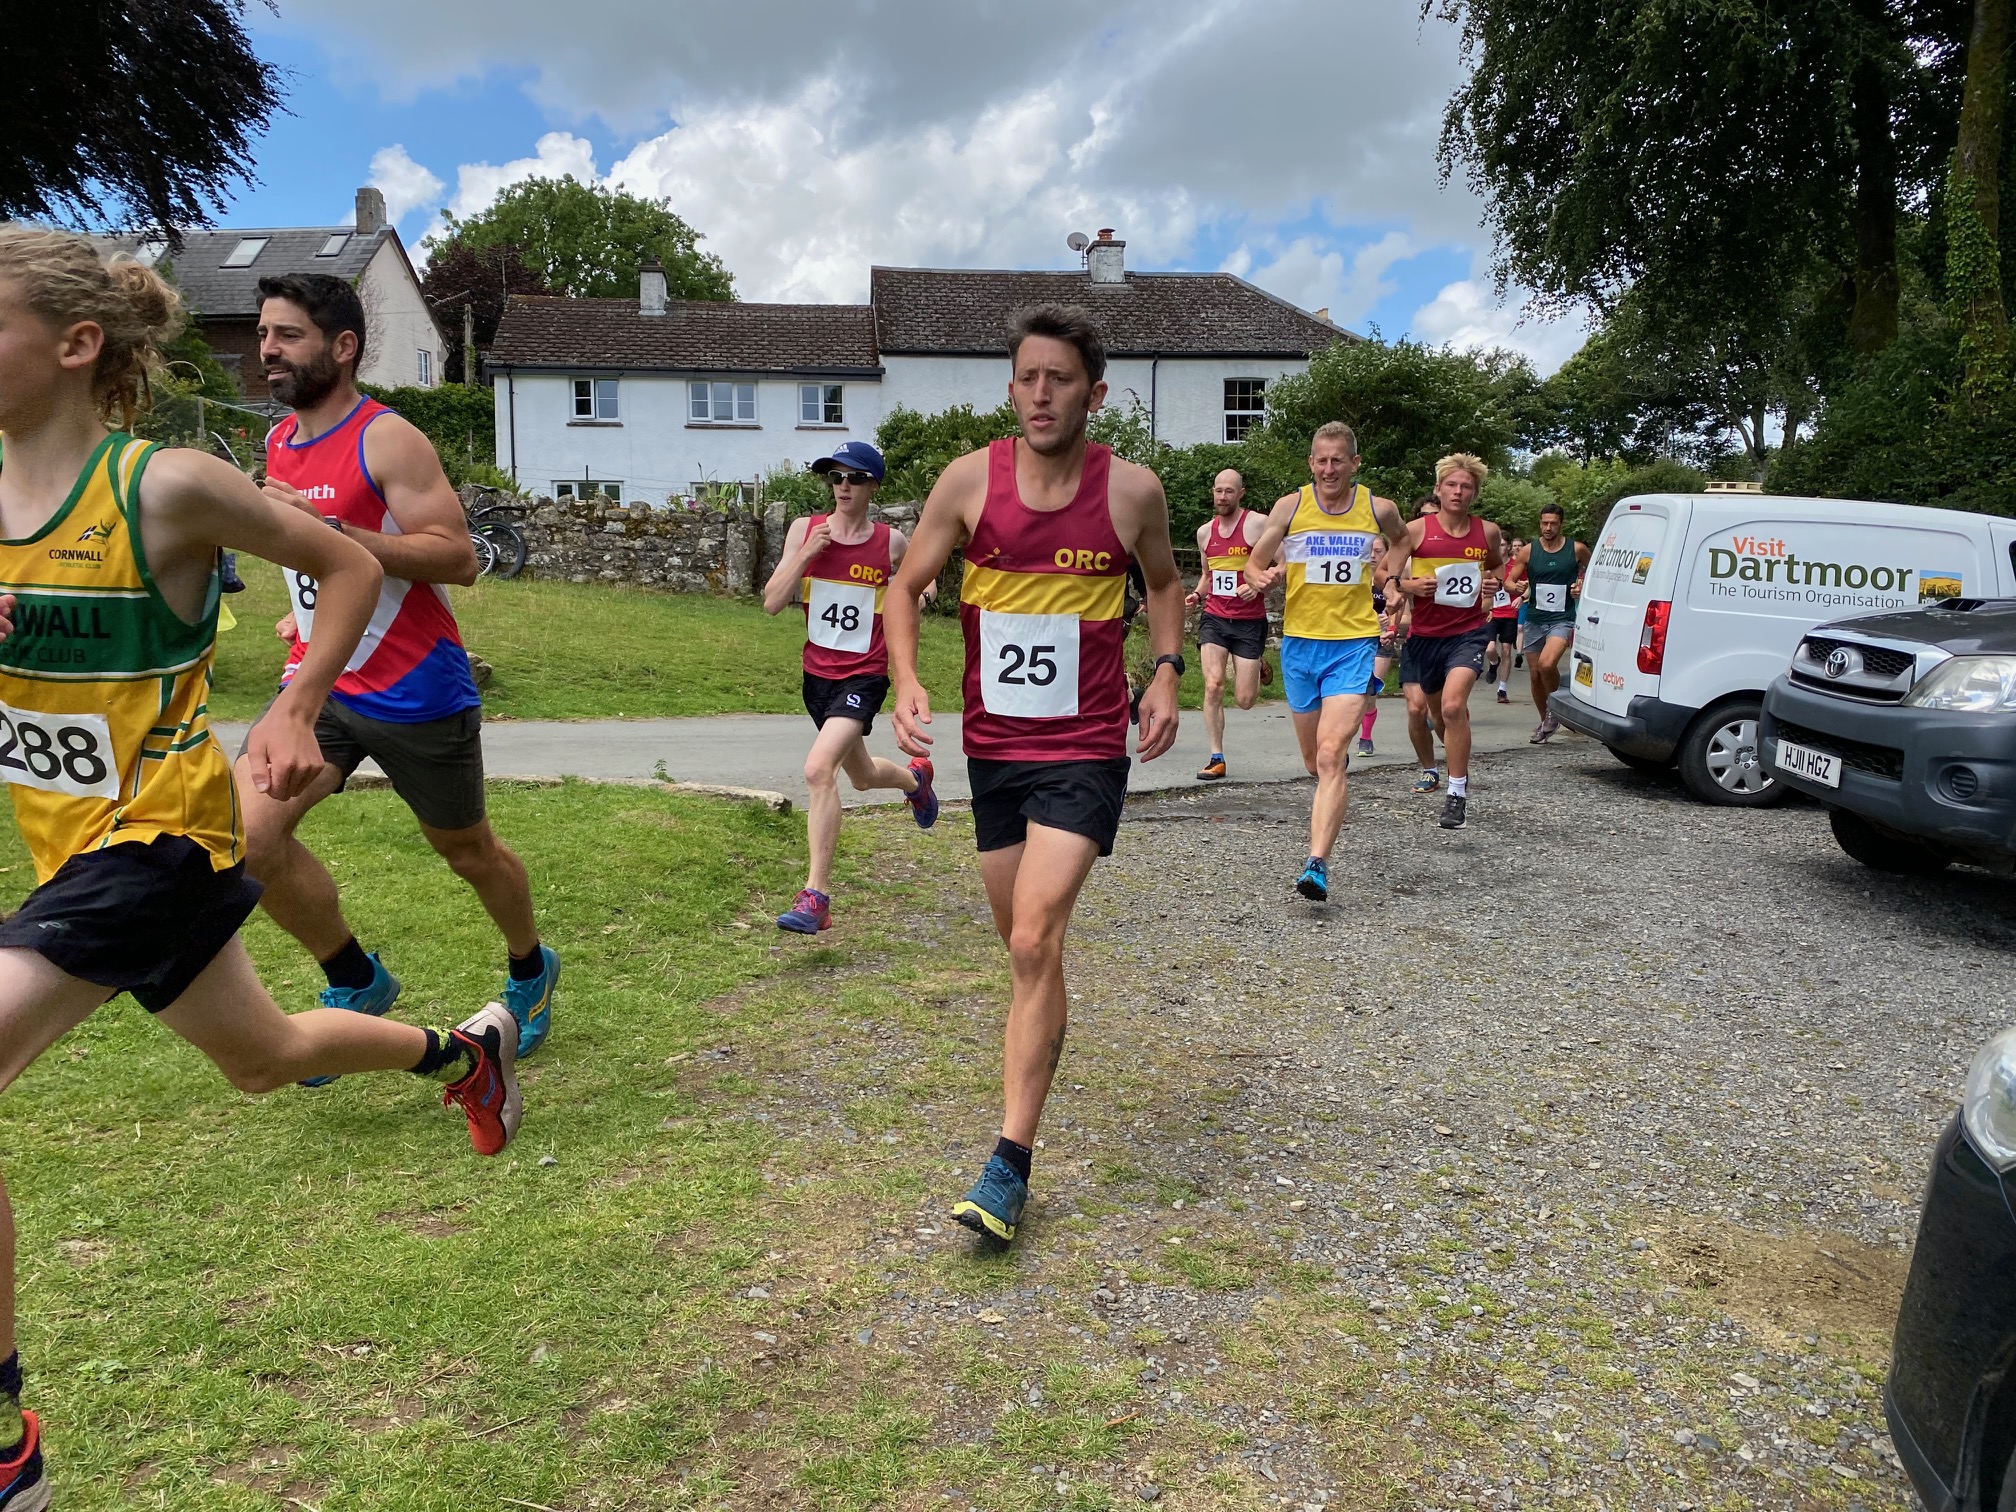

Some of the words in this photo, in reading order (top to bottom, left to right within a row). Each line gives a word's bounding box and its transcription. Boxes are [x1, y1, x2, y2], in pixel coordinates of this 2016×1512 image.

[1228, 546, 1248, 555] ORC
[1305, 536, 1325, 546] AXE
[1328, 536, 1366, 547] VALLEY
[1310, 546, 1360, 557] RUNNERS
[1733, 536, 1785, 557] Visit
[49, 549, 103, 561] CORNWALL
[1054, 548, 1112, 571] ORC
[1464, 546, 1487, 560] ORC
[1595, 543, 1640, 569] Dartmoor
[850, 563, 883, 584] ORC
[1320, 561, 1352, 583] 18
[1709, 548, 1913, 592] Dartmoor
[1215, 575, 1234, 591] 15
[1446, 576, 1473, 595] 28
[1546, 592, 1555, 603] 2
[1710, 583, 1737, 597] The
[1741, 585, 1800, 601] Tourism
[1806, 589, 1904, 608] Organisation
[821, 603, 859, 631] 48
[37, 648, 86, 663] CLUB
[998, 644, 1057, 686] 25
[0, 710, 107, 785] 288
[1807, 752, 1831, 780] HGZ
